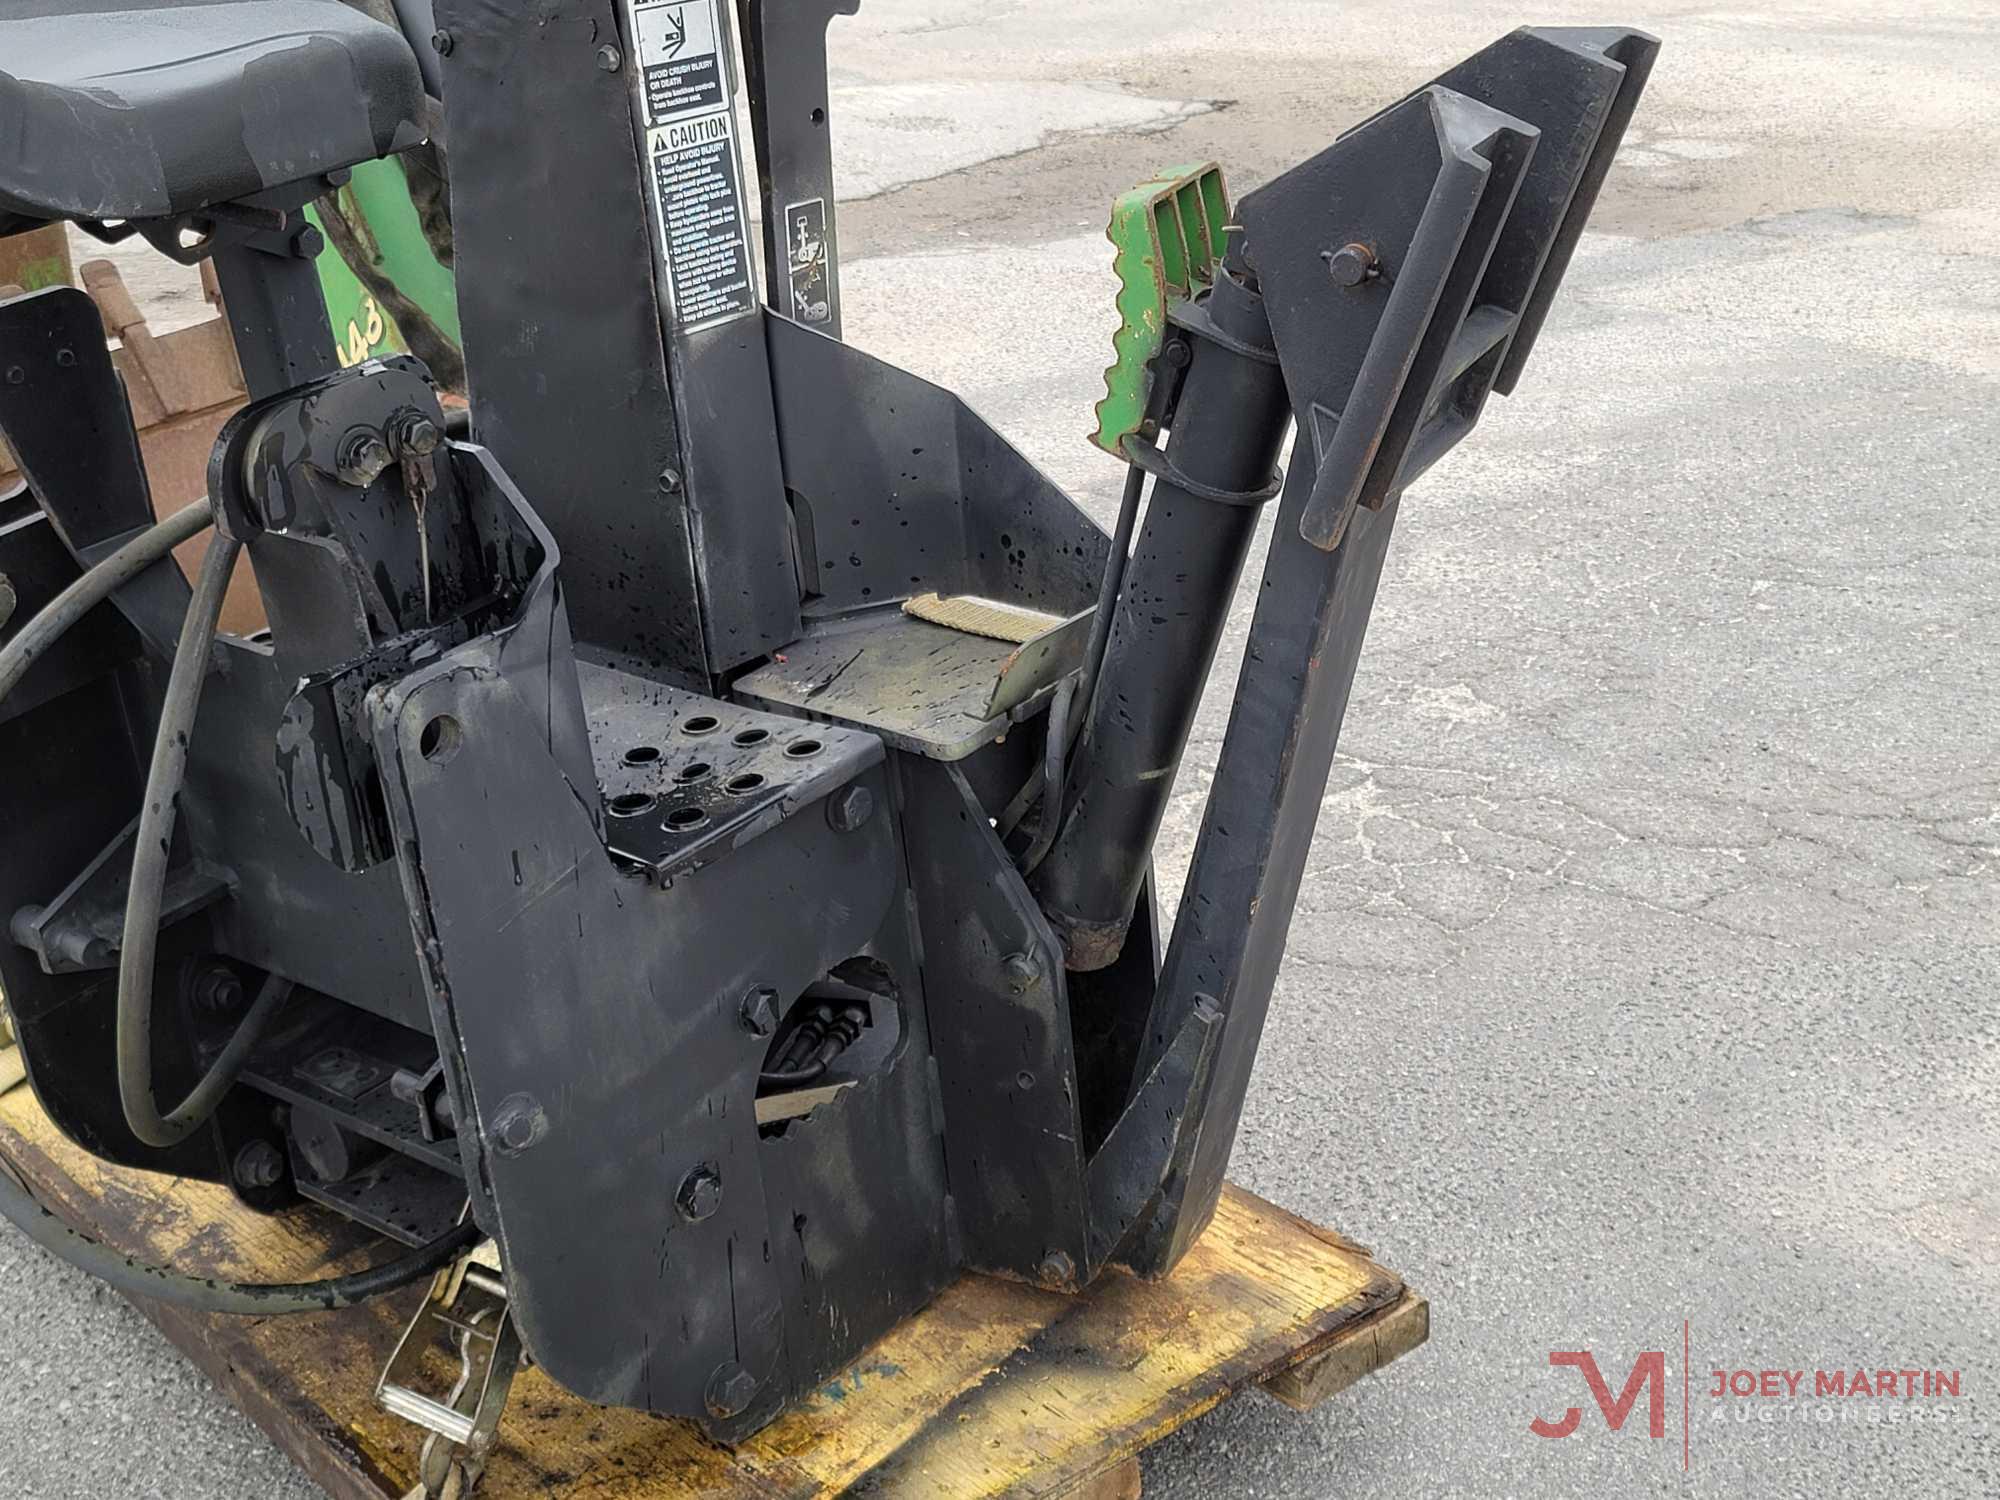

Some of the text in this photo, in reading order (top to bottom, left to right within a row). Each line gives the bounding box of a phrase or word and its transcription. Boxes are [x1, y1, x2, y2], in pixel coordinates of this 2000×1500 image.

[650, 81, 660, 90] OR
[670, 116, 728, 148] CAUTION
[661, 142, 726, 166] HELP AVOID INJURY
